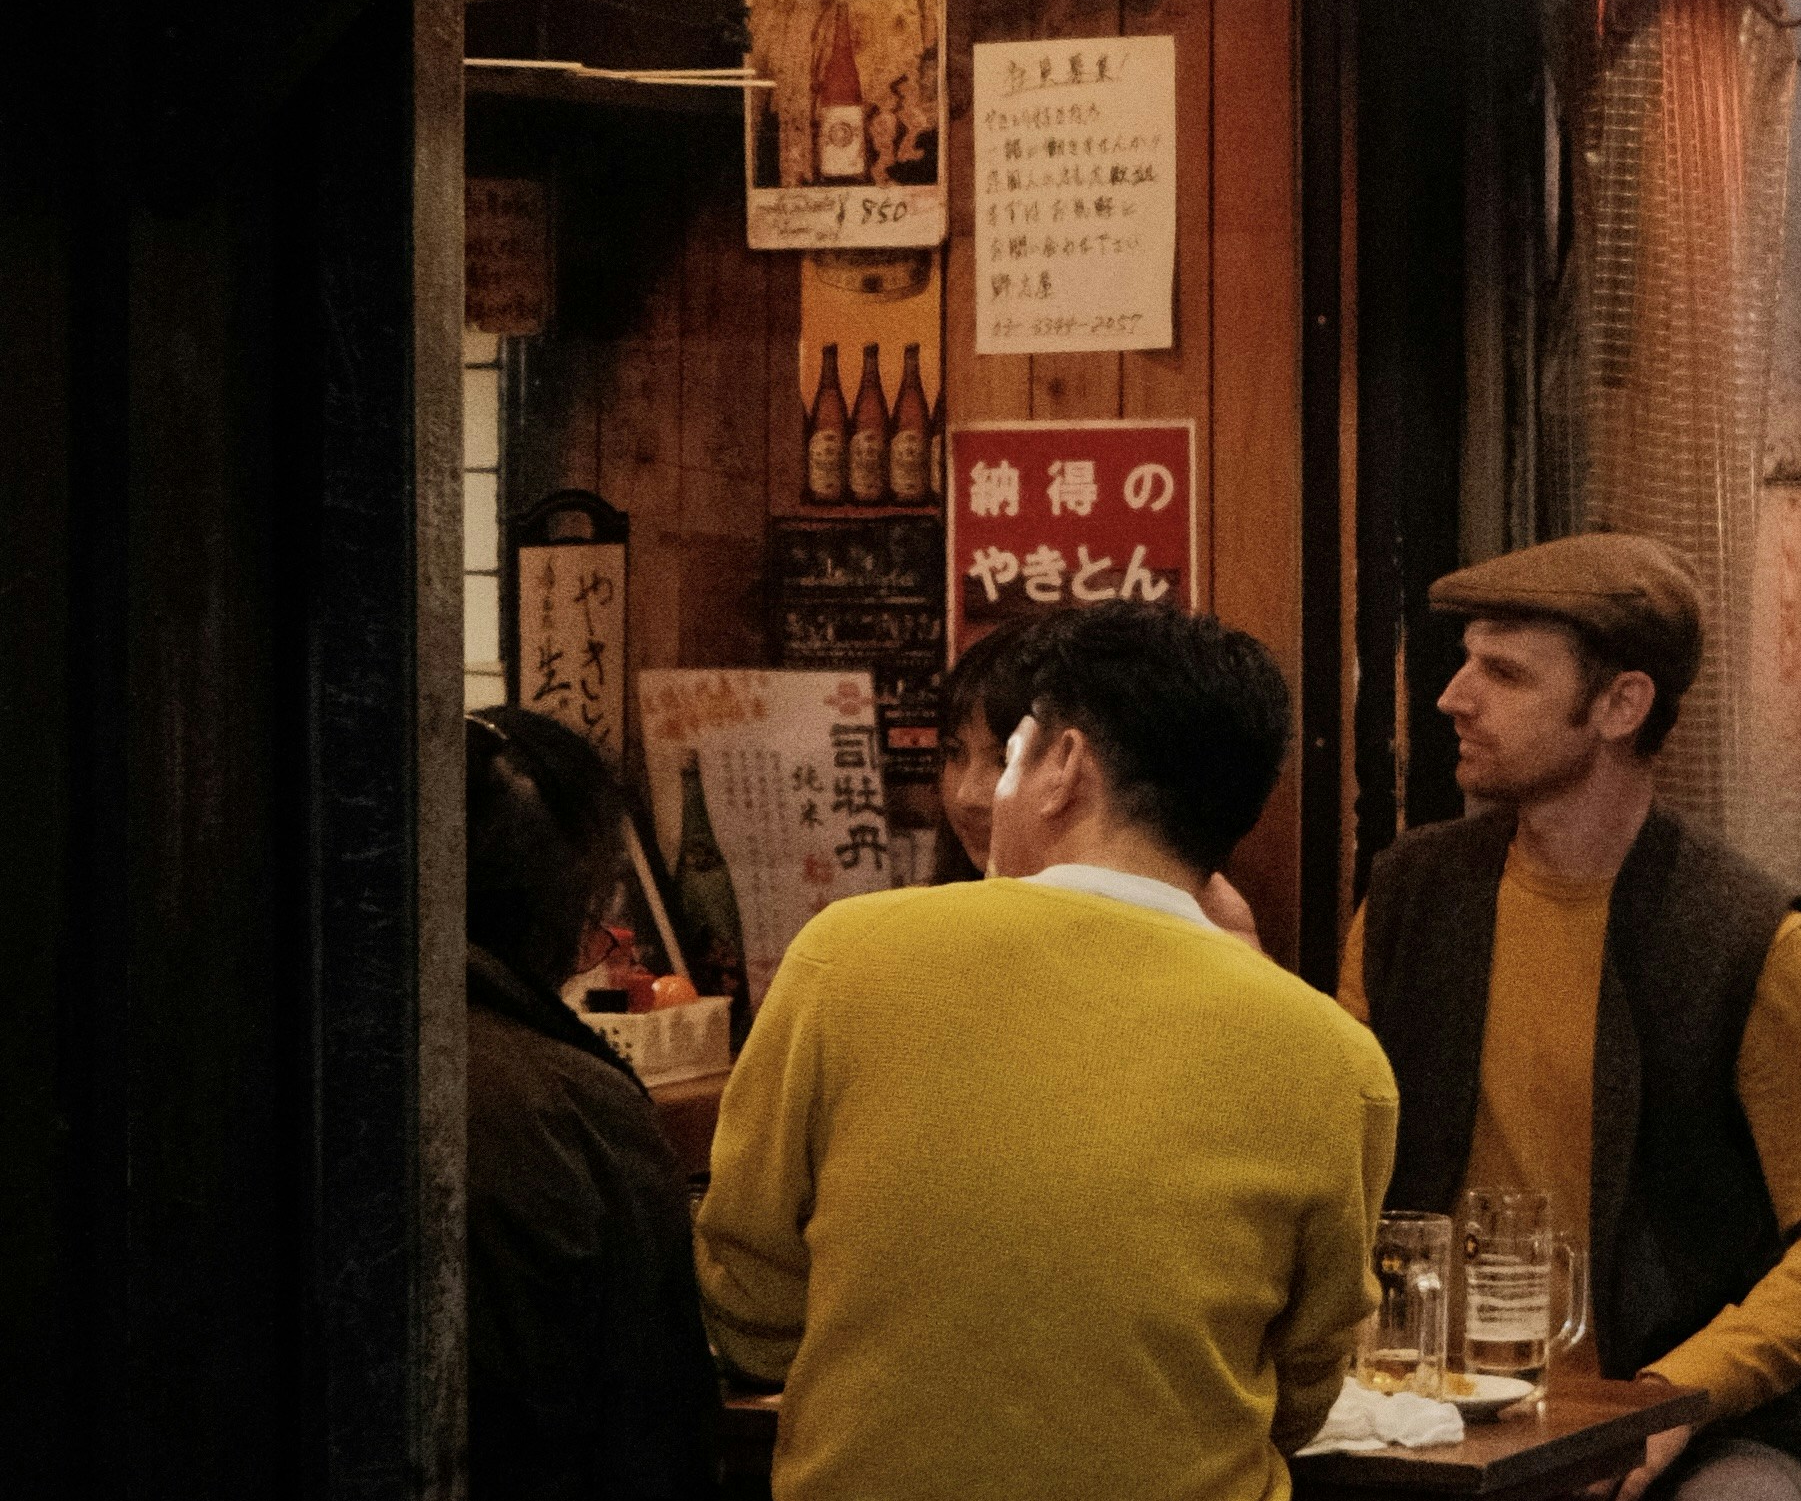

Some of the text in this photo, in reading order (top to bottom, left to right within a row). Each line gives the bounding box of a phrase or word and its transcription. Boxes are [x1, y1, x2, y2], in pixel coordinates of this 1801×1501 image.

[970, 460, 1175, 516] 納得の
[968, 545, 1170, 602] やきとん
[830, 723, 888, 871] 司牡丹
